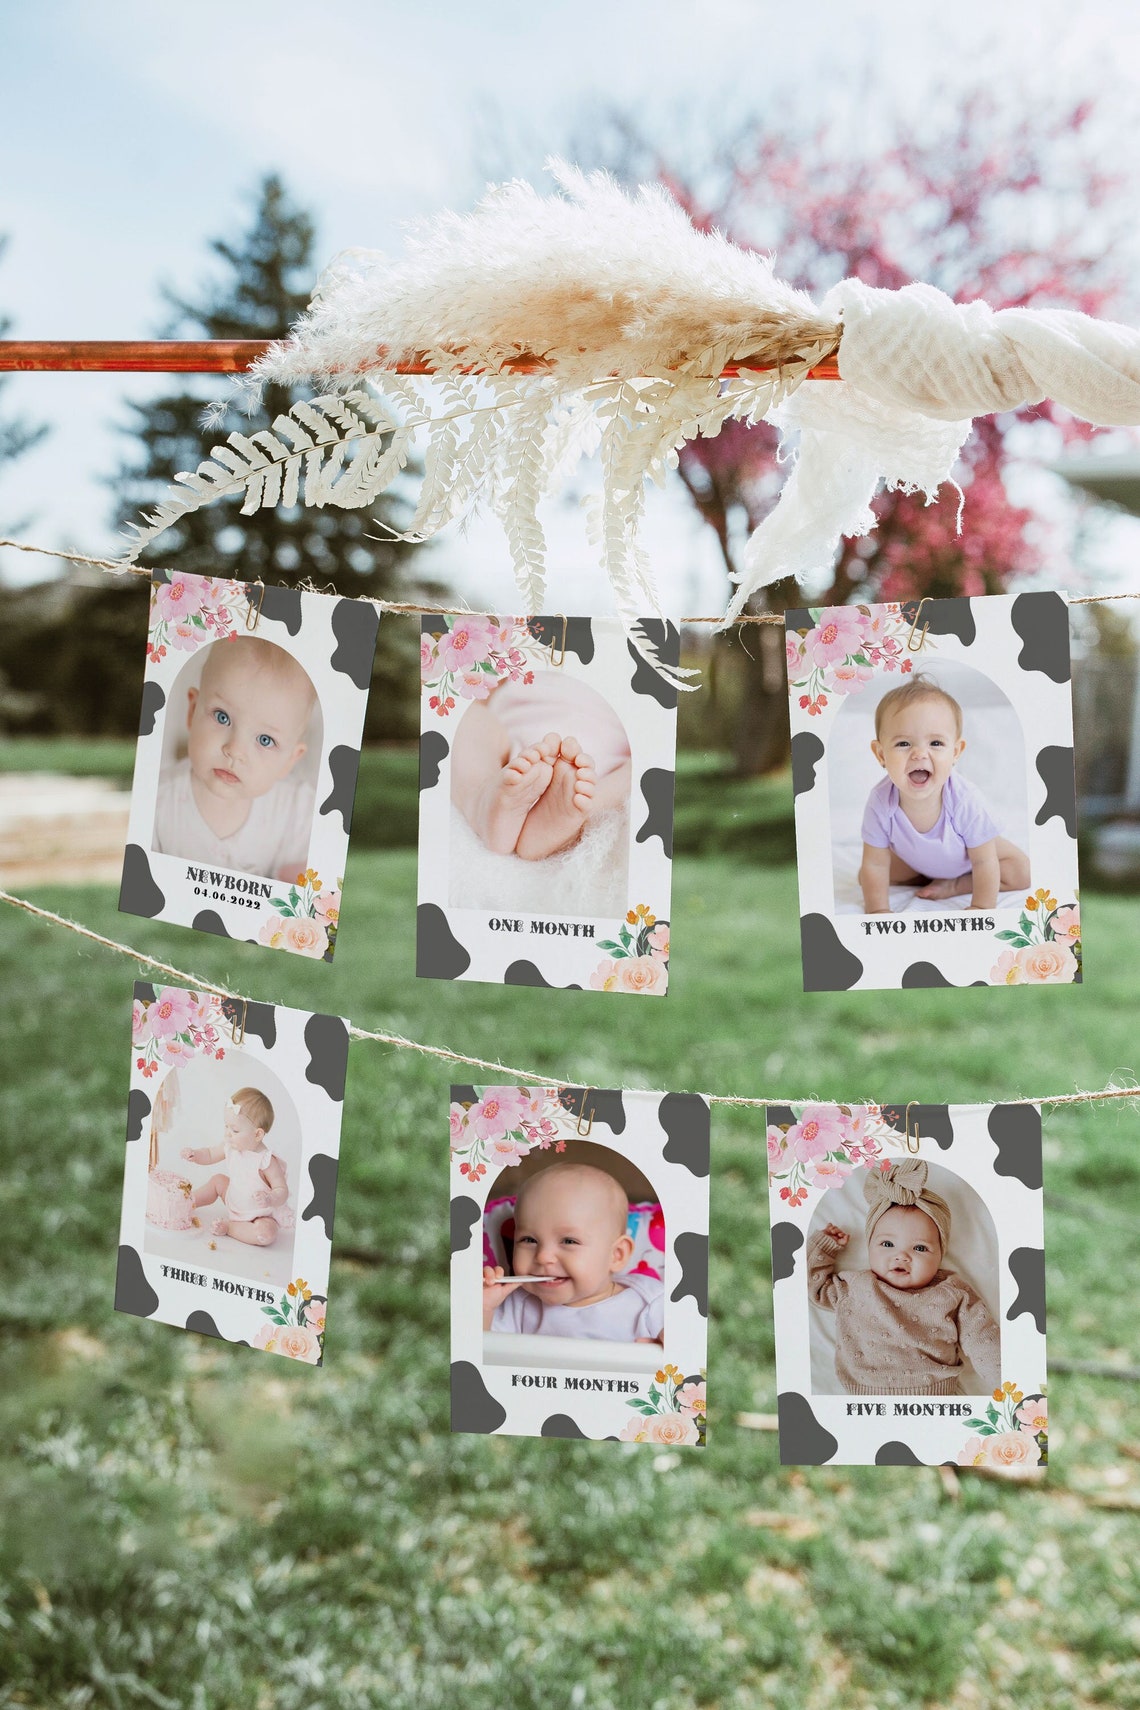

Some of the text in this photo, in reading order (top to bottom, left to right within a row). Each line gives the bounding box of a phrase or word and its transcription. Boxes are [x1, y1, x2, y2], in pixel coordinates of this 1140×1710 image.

[186, 866, 274, 899] NEWBORN
[193, 886, 261, 910] 04.06.2022
[488, 918, 596, 938] ONE MONTH
[861, 917, 996, 937] TWO MONTHS
[160, 1264, 275, 1305] THREE MONTHS
[511, 1374, 640, 1393] FOUR MONTHS
[846, 1402, 973, 1417] FIVE MONTHS
